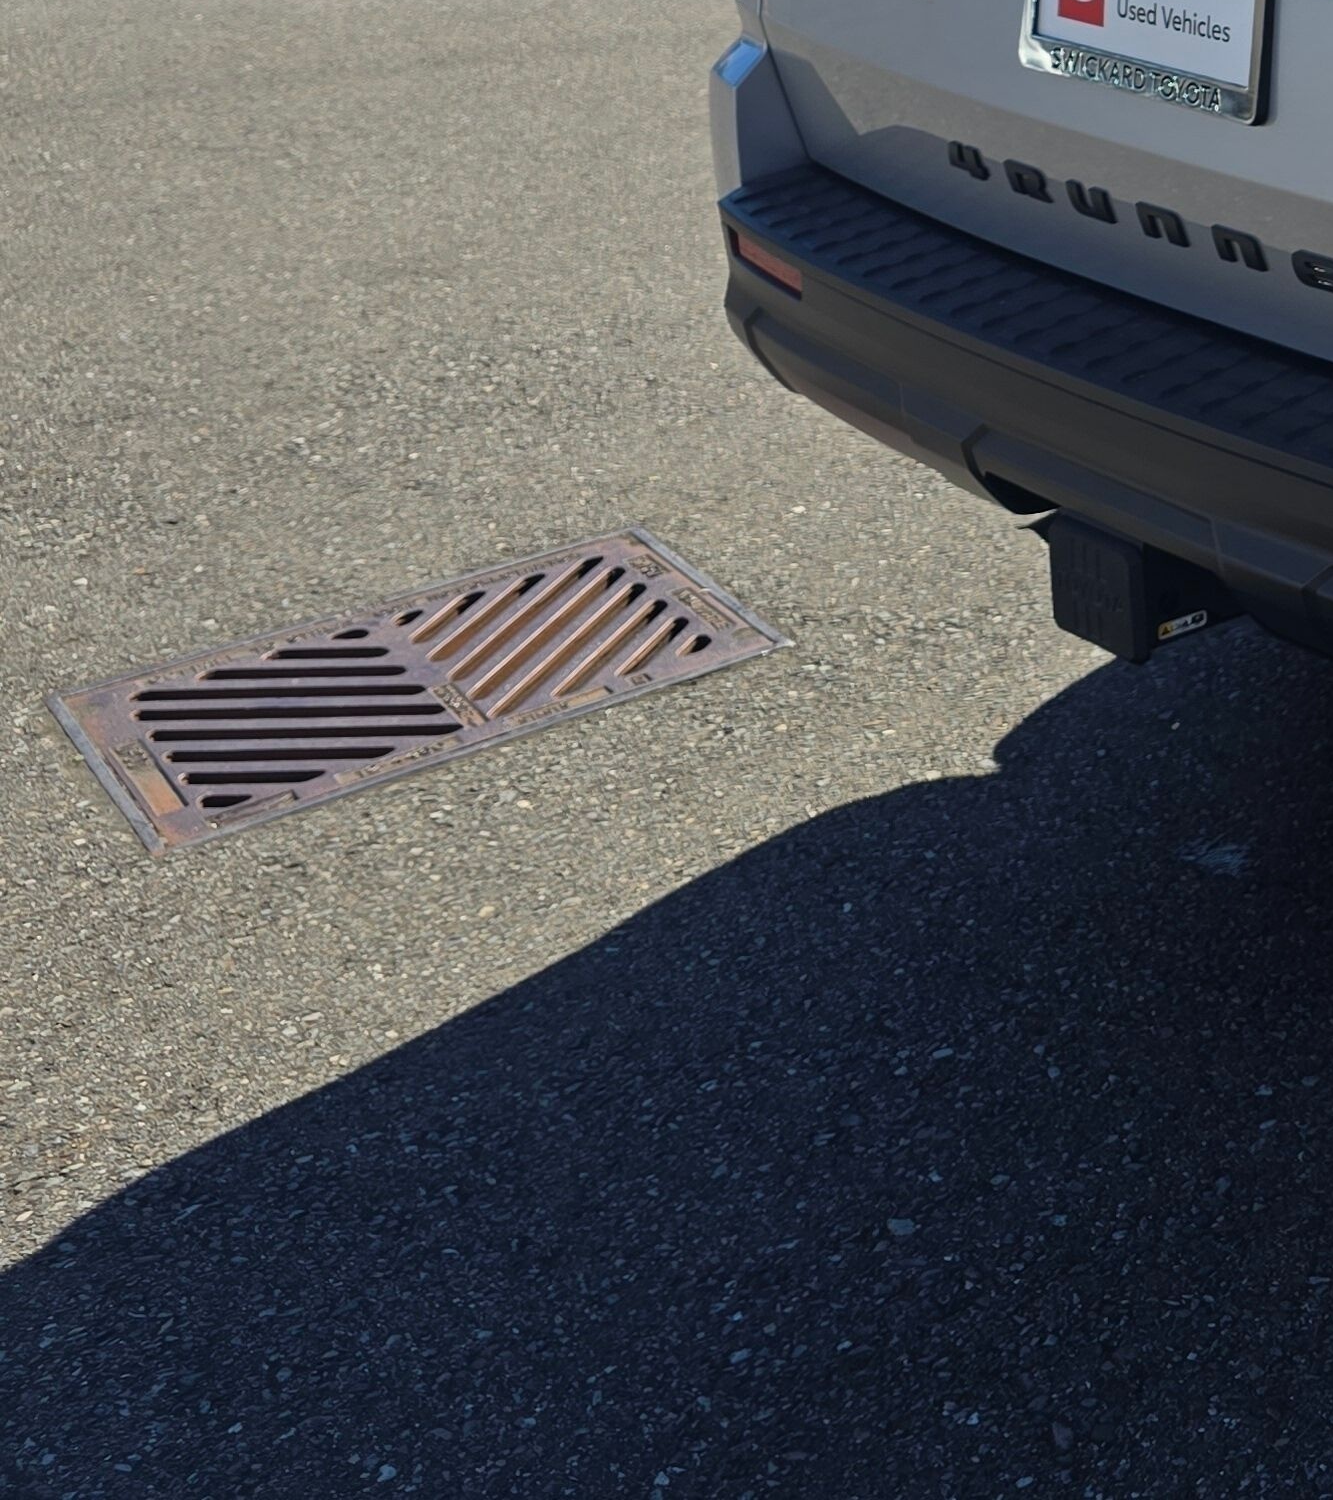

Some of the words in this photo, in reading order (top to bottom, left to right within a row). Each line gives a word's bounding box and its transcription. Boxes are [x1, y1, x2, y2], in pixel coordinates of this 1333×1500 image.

[1162, 7, 1231, 43] Vehicles
[1050, 47, 1146, 90] SWICKARD
[1150, 72, 1222, 111] TOYOTA
